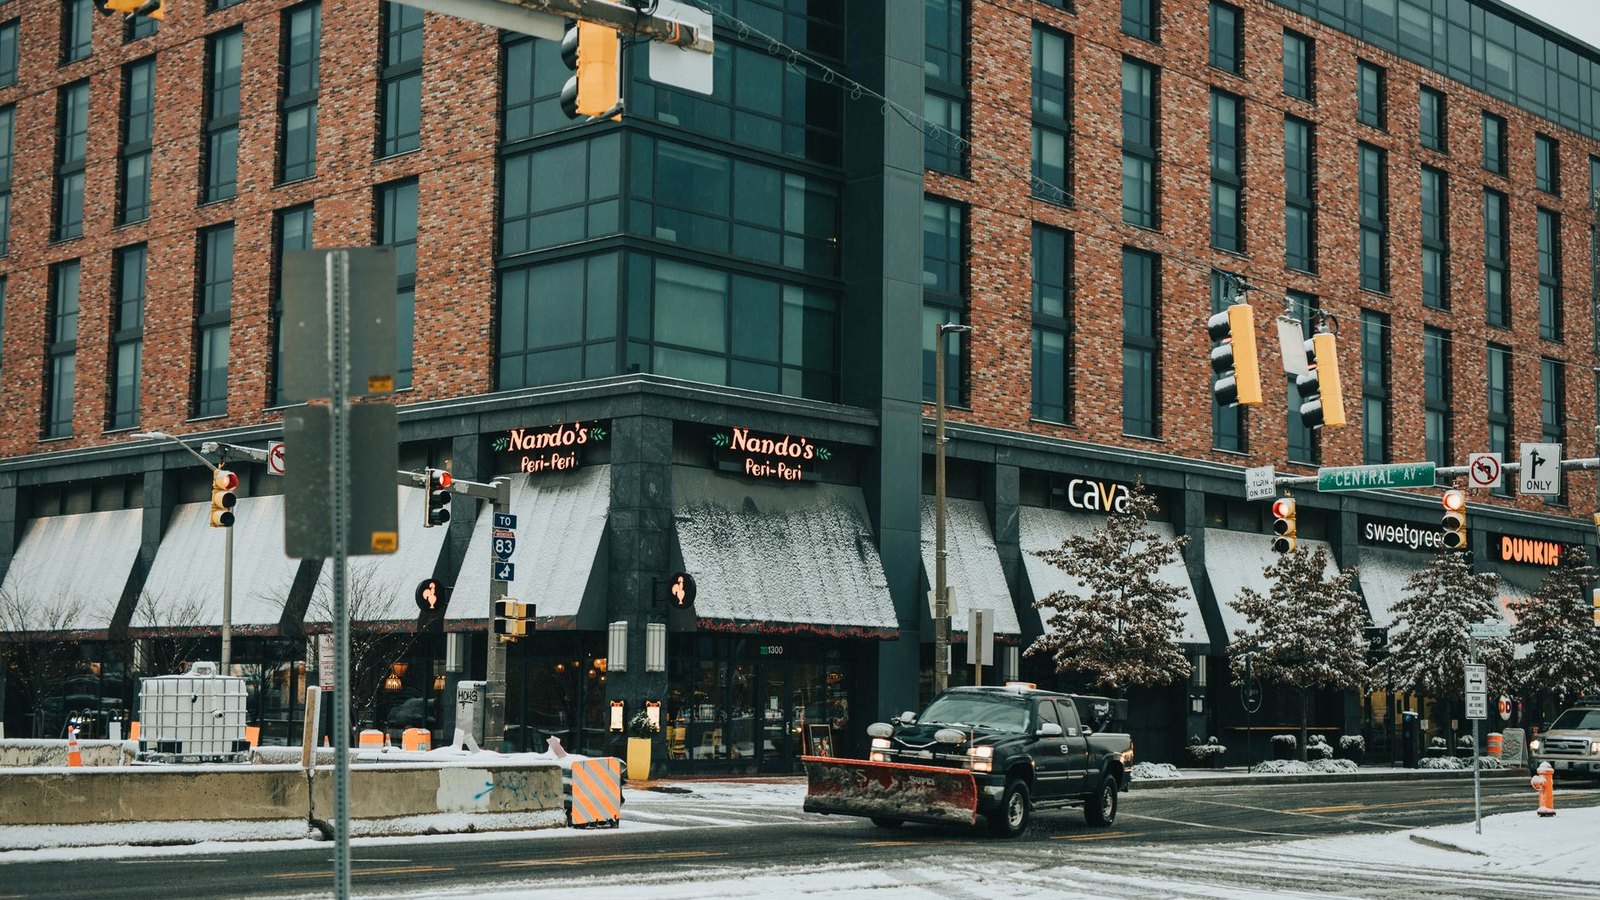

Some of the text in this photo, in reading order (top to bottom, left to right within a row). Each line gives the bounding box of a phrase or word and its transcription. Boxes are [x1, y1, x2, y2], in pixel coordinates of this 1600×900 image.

[508, 422, 588, 451] Nando's
[730, 427, 814, 459] Nando's
[521, 451, 574, 472] Peri-Peri
[745, 458, 802, 480] Peri-Peri
[1335, 467, 1417, 486] CENTRAL AV
[1260, 487, 1273, 495] RED
[1526, 480, 1552, 491] ONLY
[499, 516, 511, 526] TO
[1366, 522, 1442, 549] sweetgree
[495, 539, 513, 553] 83
[767, 645, 784, 655] 1300
[1498, 700, 1512, 714] DD
